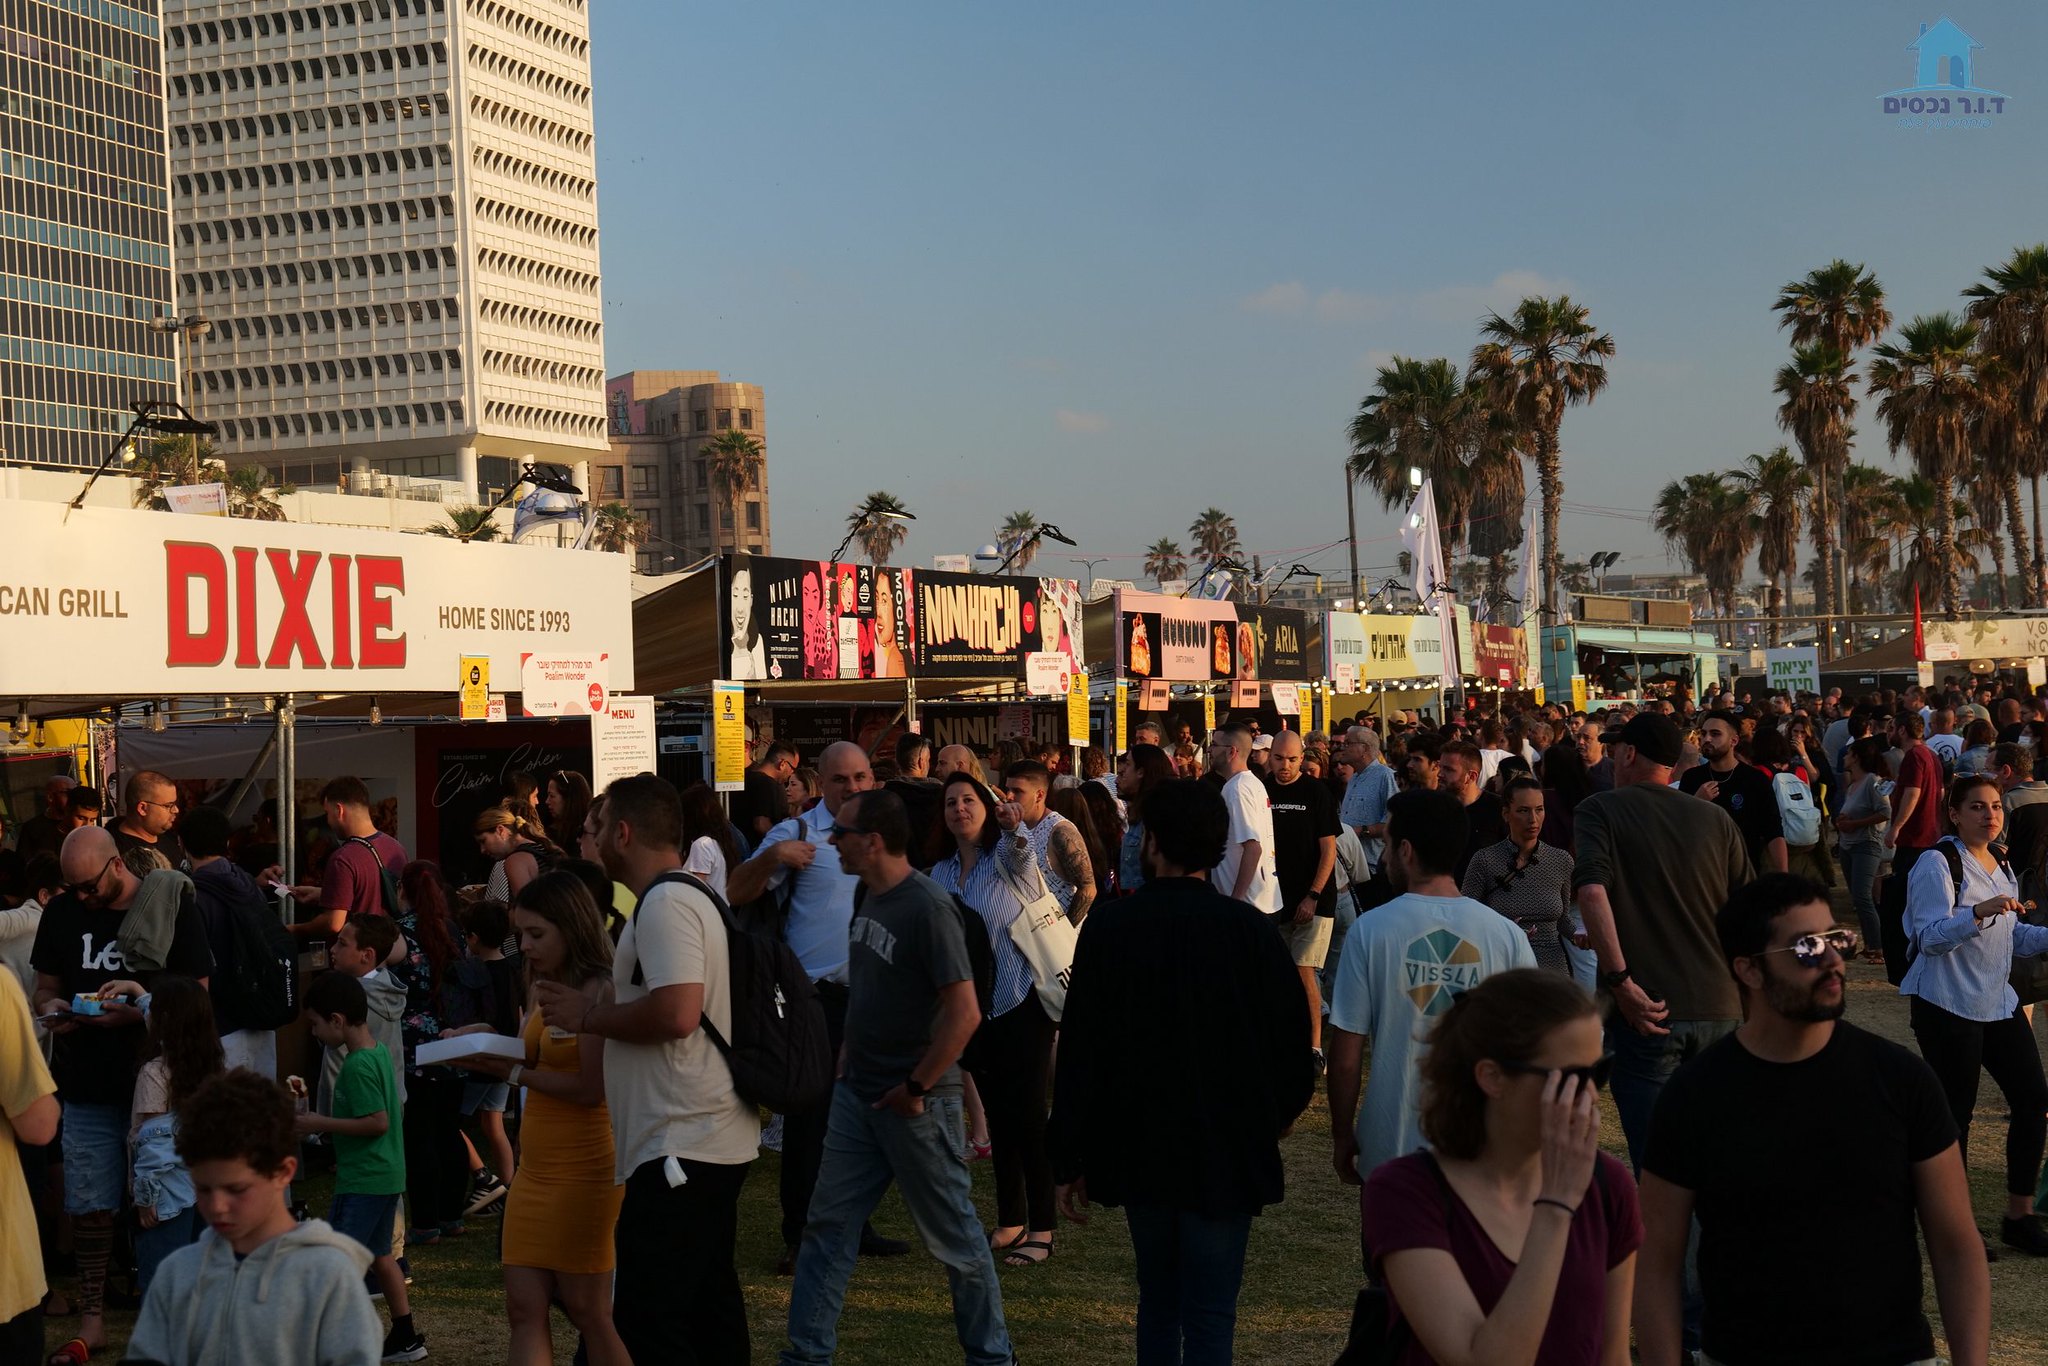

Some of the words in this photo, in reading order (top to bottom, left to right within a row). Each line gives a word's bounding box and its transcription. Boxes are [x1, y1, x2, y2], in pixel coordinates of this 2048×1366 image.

[0, 586, 49, 615] CAN
[59, 588, 128, 618] GRILL
[163, 539, 407, 670] DIXIE
[769, 577, 797, 604] NINI
[439, 605, 486, 630] HOME
[490, 607, 535, 632] SINCE
[539, 610, 570, 633] 1993
[770, 607, 799, 627] HACHI
[894, 572, 904, 641] MOCHI
[1162, 616, 1207, 649] NUNUNU
[1275, 625, 1299, 653] ARIA
[545, 671, 564, 681] Poalim
[565, 671, 586, 681] Wonder
[1771, 660, 1813, 675] יציאת
[612, 709, 635, 720] MENU
[1022, 709, 1030, 737] MOC
[933, 713, 1059, 749] NINIHHI
[431, 762, 495, 808] Chaim
[499, 742, 562, 785] Cohen
[81, 932, 123, 971] Le
[865, 918, 897, 965] YORK
[1405, 962, 1480, 988] VISSLA
